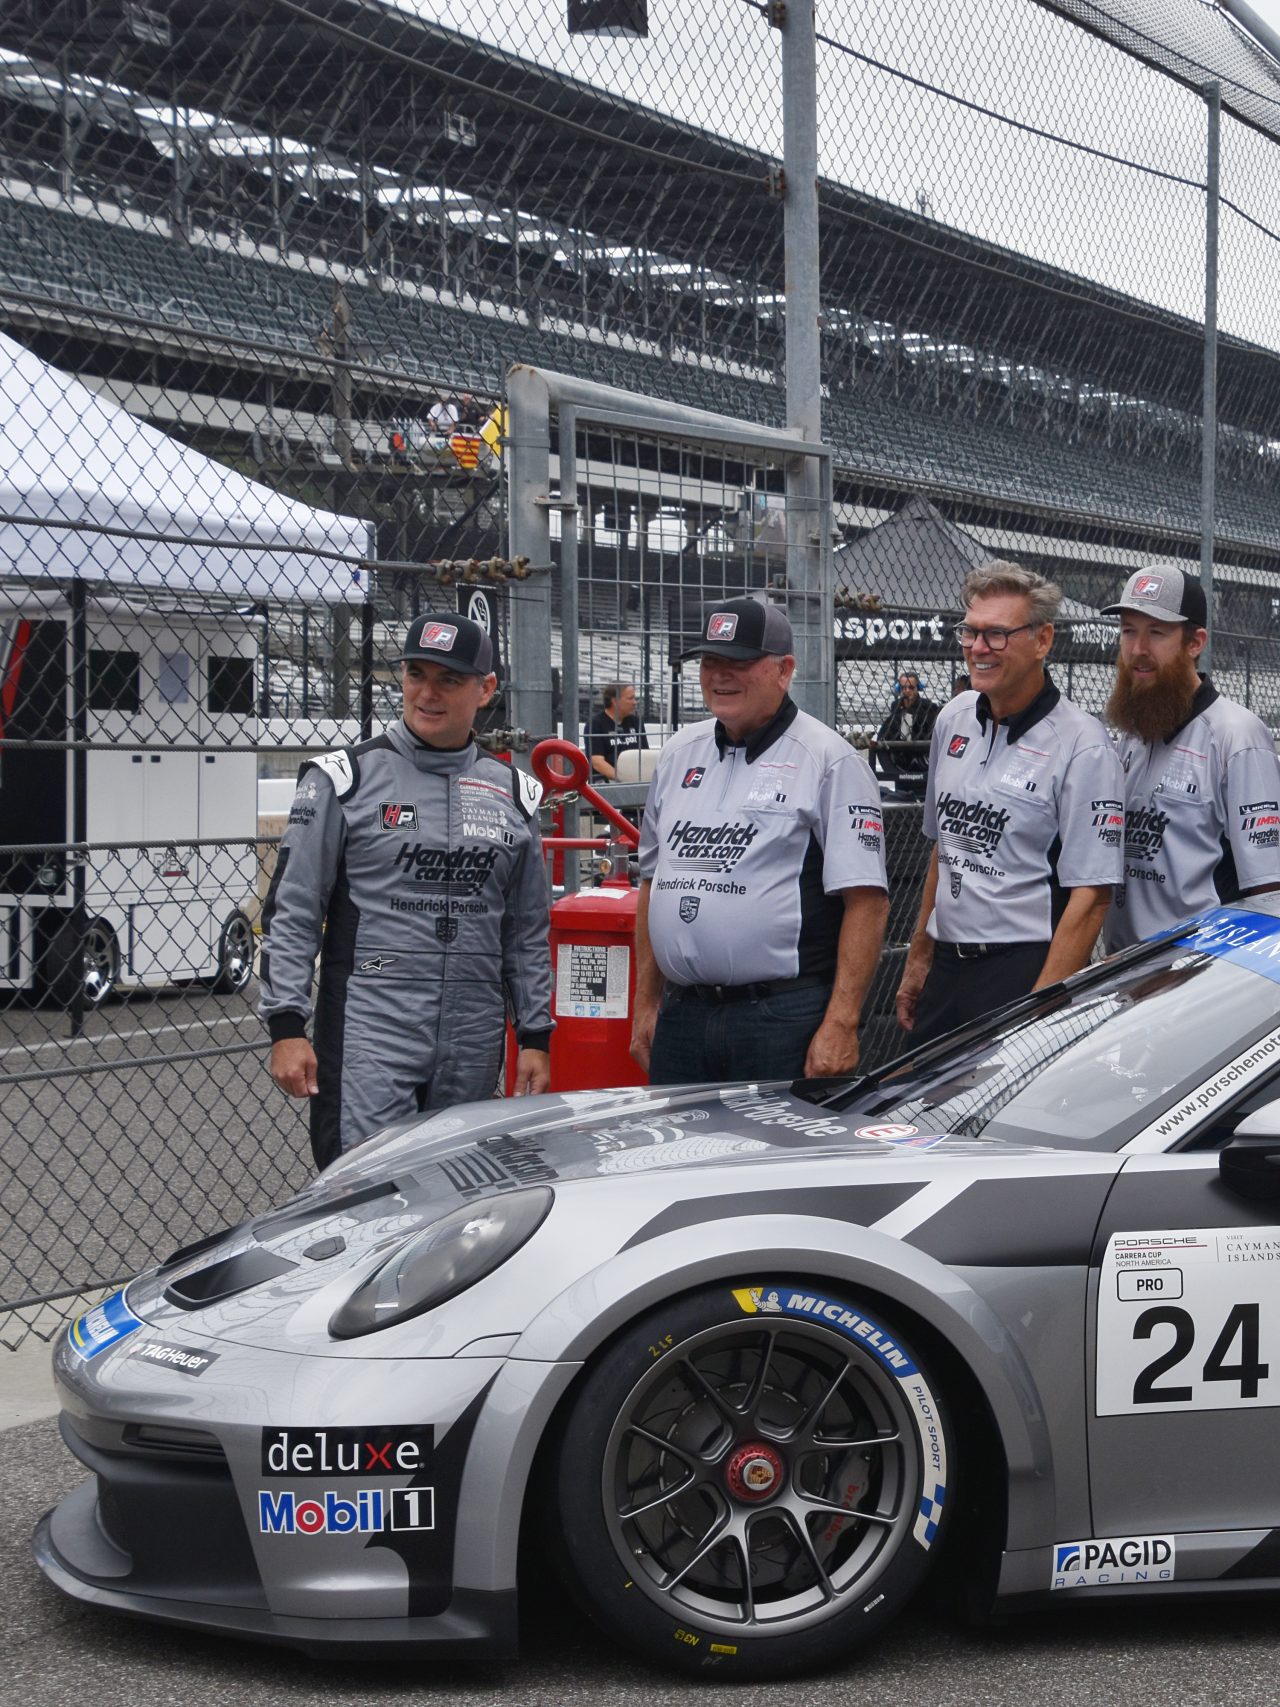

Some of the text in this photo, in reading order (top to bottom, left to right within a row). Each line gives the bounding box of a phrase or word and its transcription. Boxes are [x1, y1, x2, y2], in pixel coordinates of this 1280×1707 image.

[384, 805, 414, 827] HP
[937, 792, 1011, 832] Hendrick
[1125, 806, 1170, 835] ndrick
[463, 822, 502, 840] Mobil
[666, 821, 758, 850] Hendrick
[394, 843, 499, 873] Hendrick
[678, 845, 746, 860] cars.com
[656, 878, 747, 895] Hendrick Porsche
[390, 898, 488, 914] Hendrick Porsche
[1114, 1236, 1198, 1247] PORSCHE
[1226, 1241, 1280, 1252] CAYMAN
[1115, 1251, 1162, 1260] CARRERA CUP
[1141, 1259, 1172, 1267] AMERICA
[1136, 1278, 1164, 1291] PRO
[787, 1293, 909, 1369] MICHELIN
[1133, 1303, 1269, 1404] 24
[912, 1385, 941, 1472] PILOT SPORT
[268, 1432, 420, 1471] deluxe
[258, 1489, 385, 1535] Mobil
[1084, 1540, 1172, 1570] PAGID
[1055, 1570, 1171, 1587] RACING
